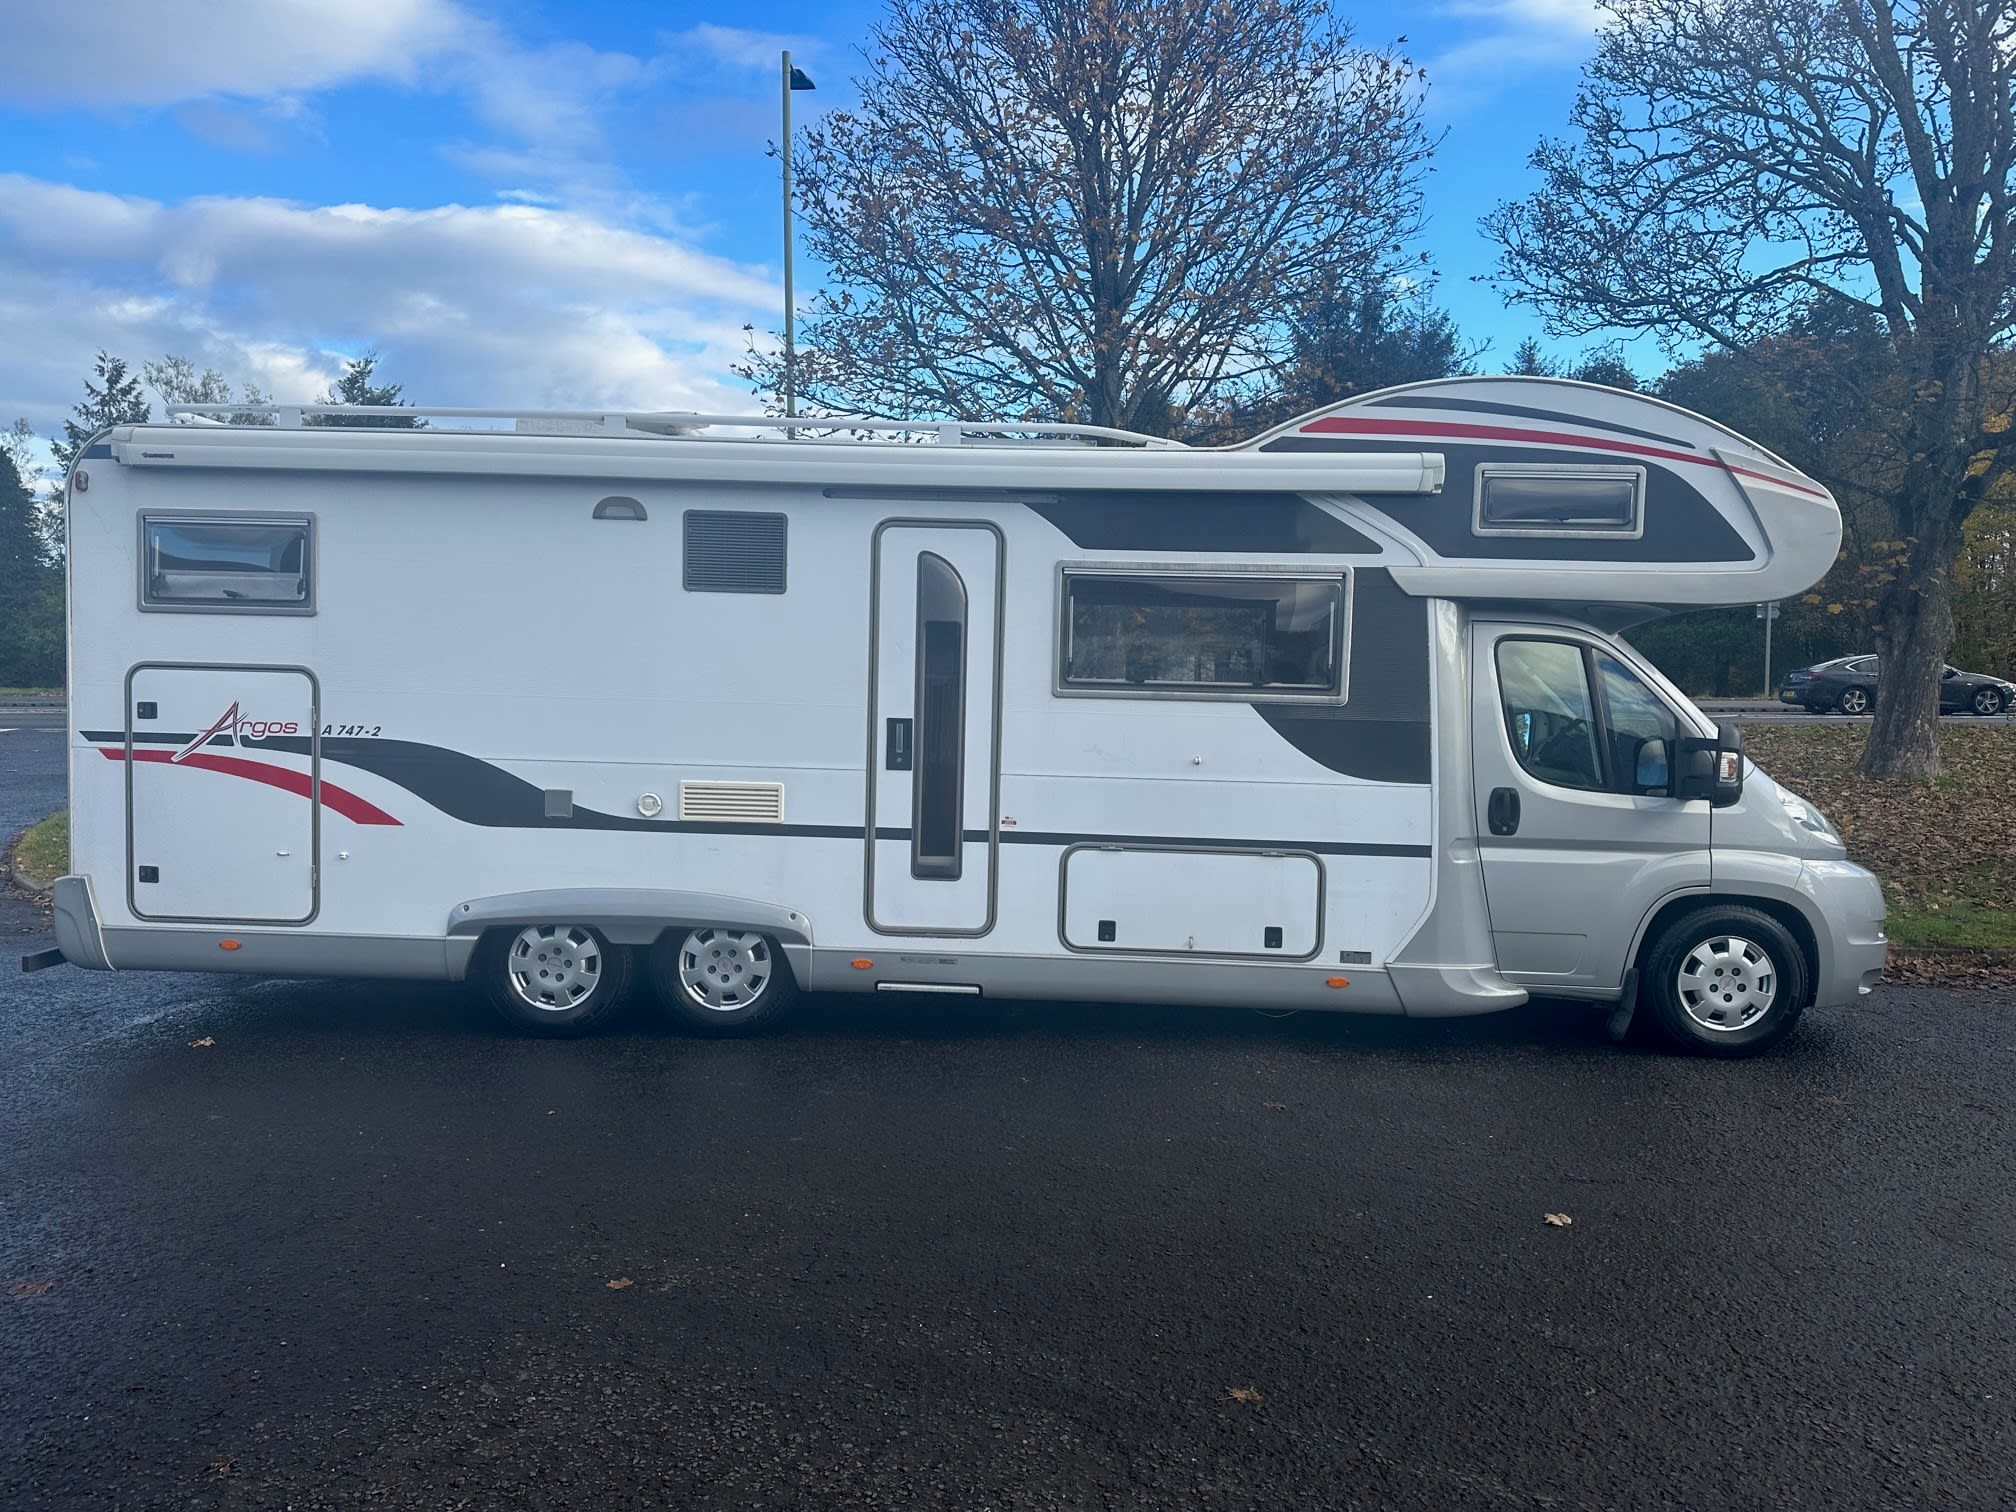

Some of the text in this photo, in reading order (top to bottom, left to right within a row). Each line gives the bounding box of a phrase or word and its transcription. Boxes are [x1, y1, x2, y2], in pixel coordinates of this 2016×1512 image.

[172, 700, 298, 761] Argos
[321, 725, 381, 737] A 747-2
